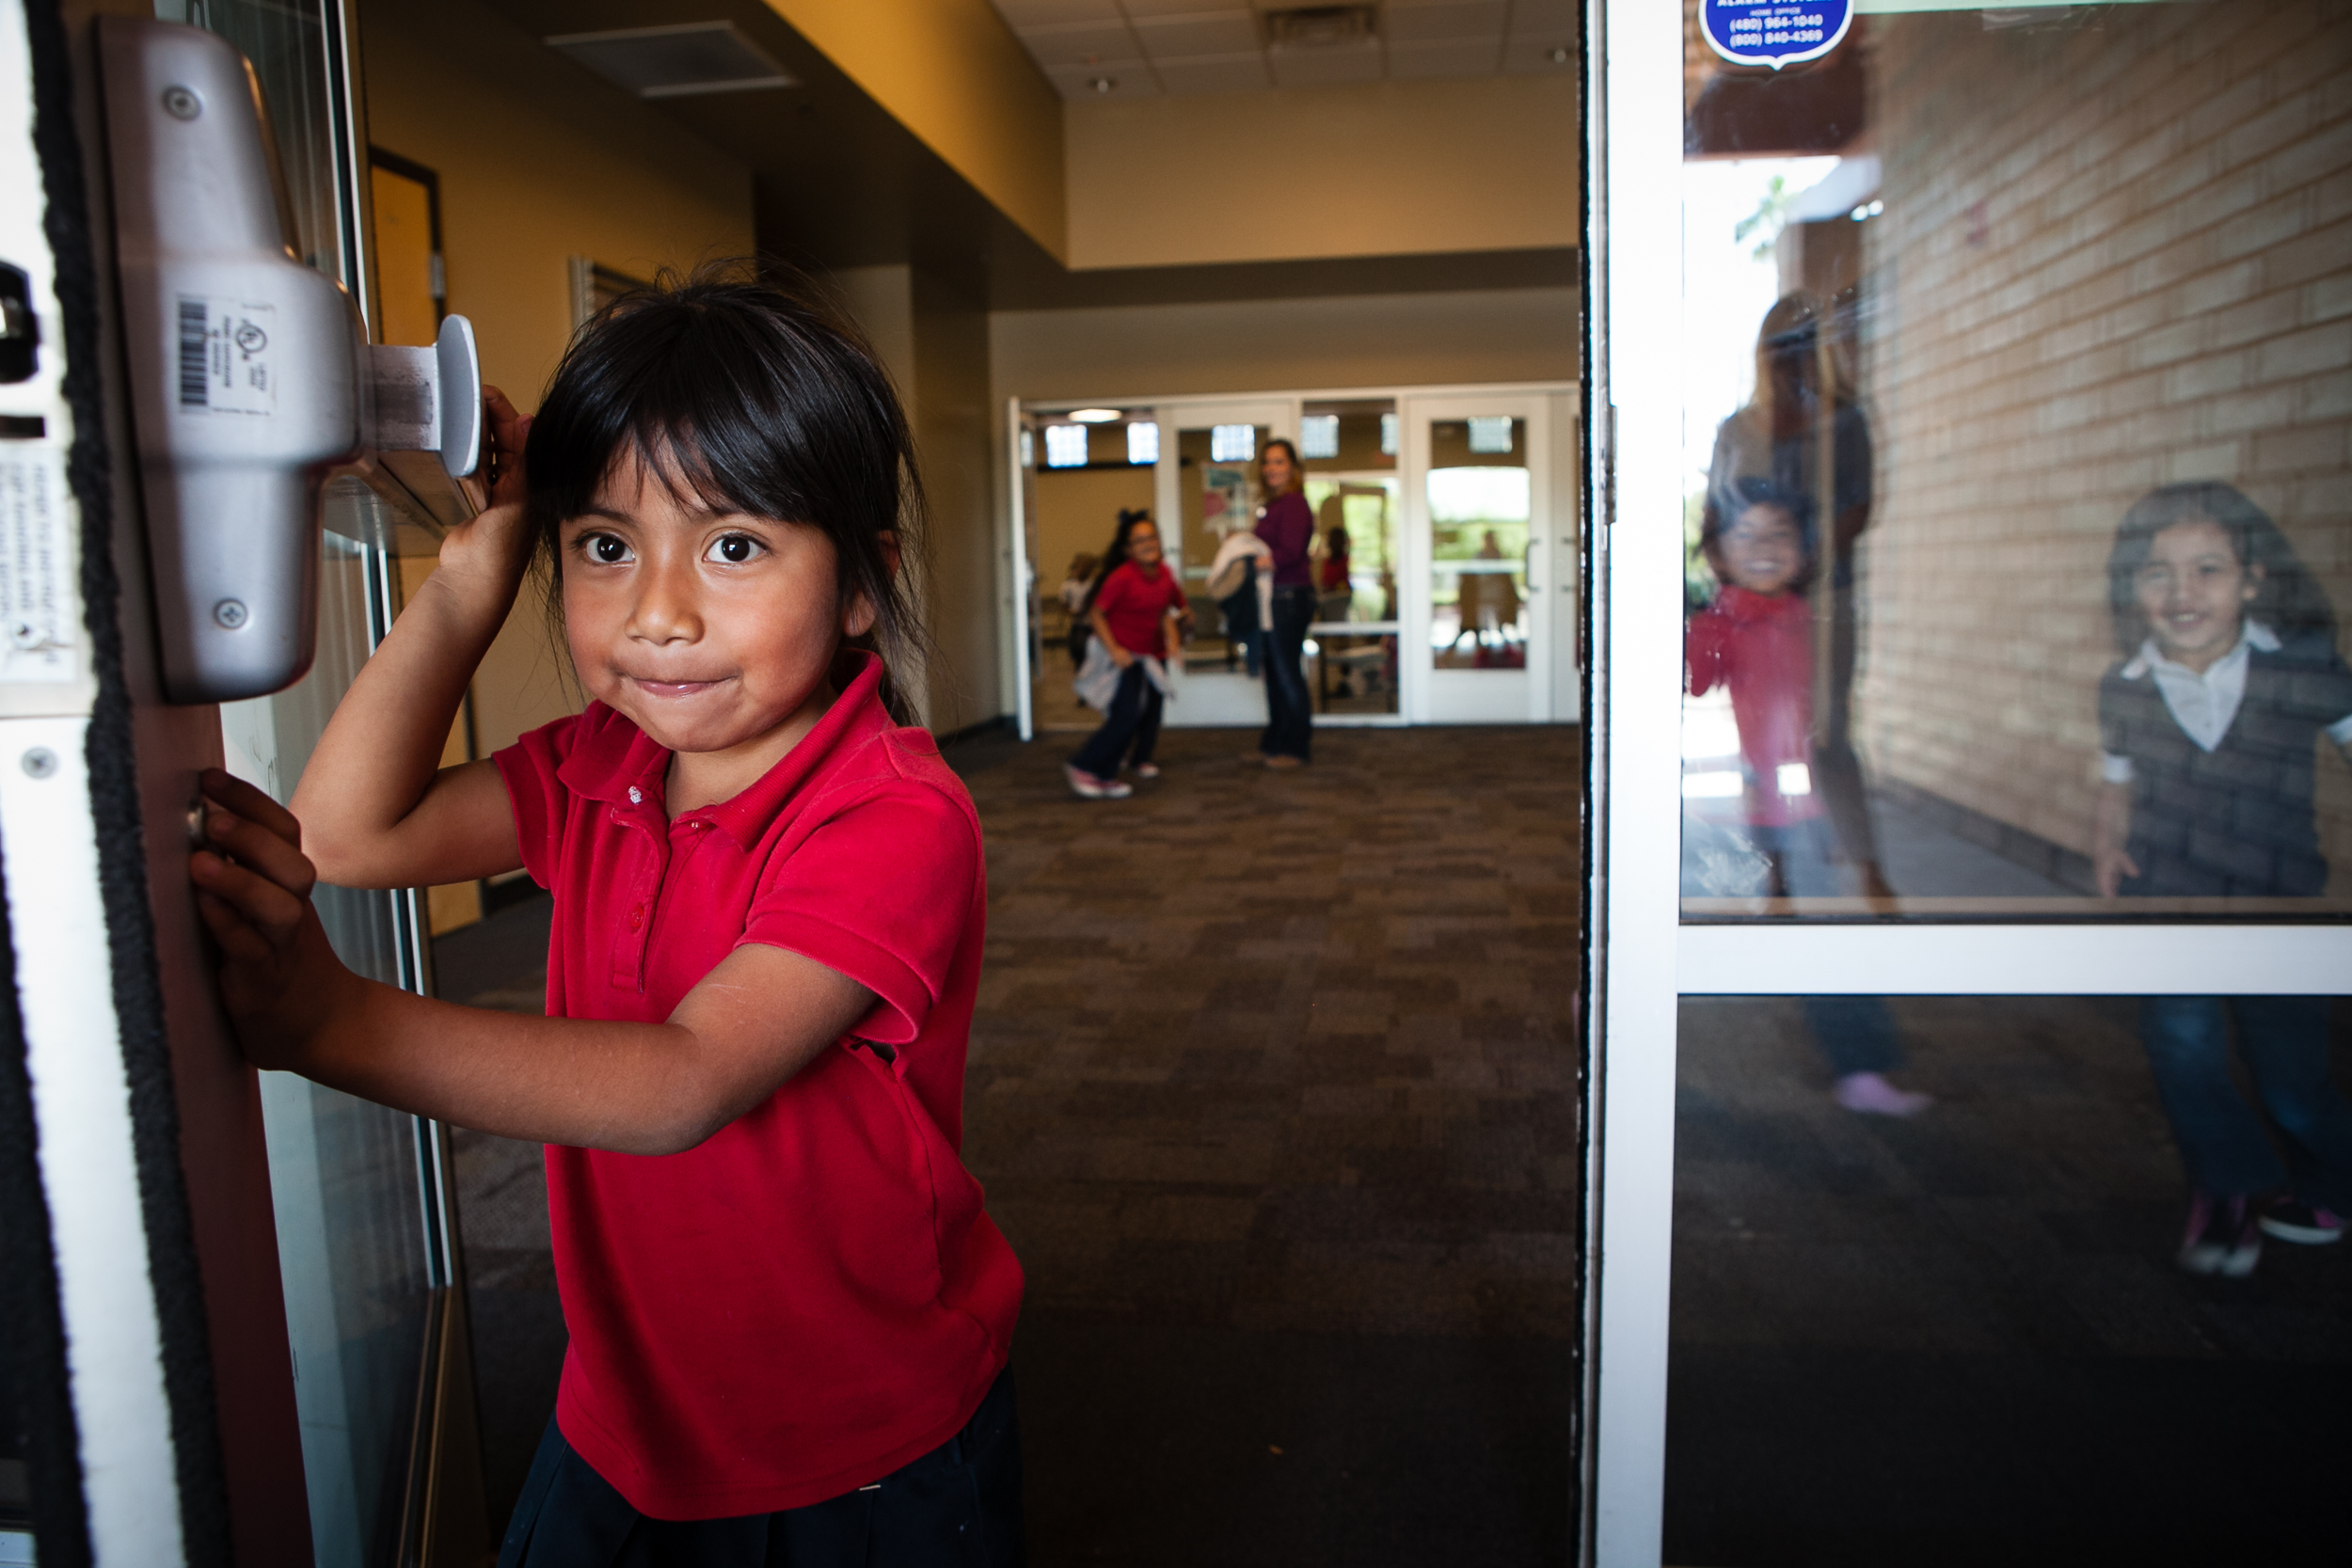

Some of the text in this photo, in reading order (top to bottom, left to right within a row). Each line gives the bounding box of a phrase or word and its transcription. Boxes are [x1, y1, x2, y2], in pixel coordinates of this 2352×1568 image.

[1729, 13, 1823, 33] (480) 964-1040
[1729, 32, 1763, 49] (800)
